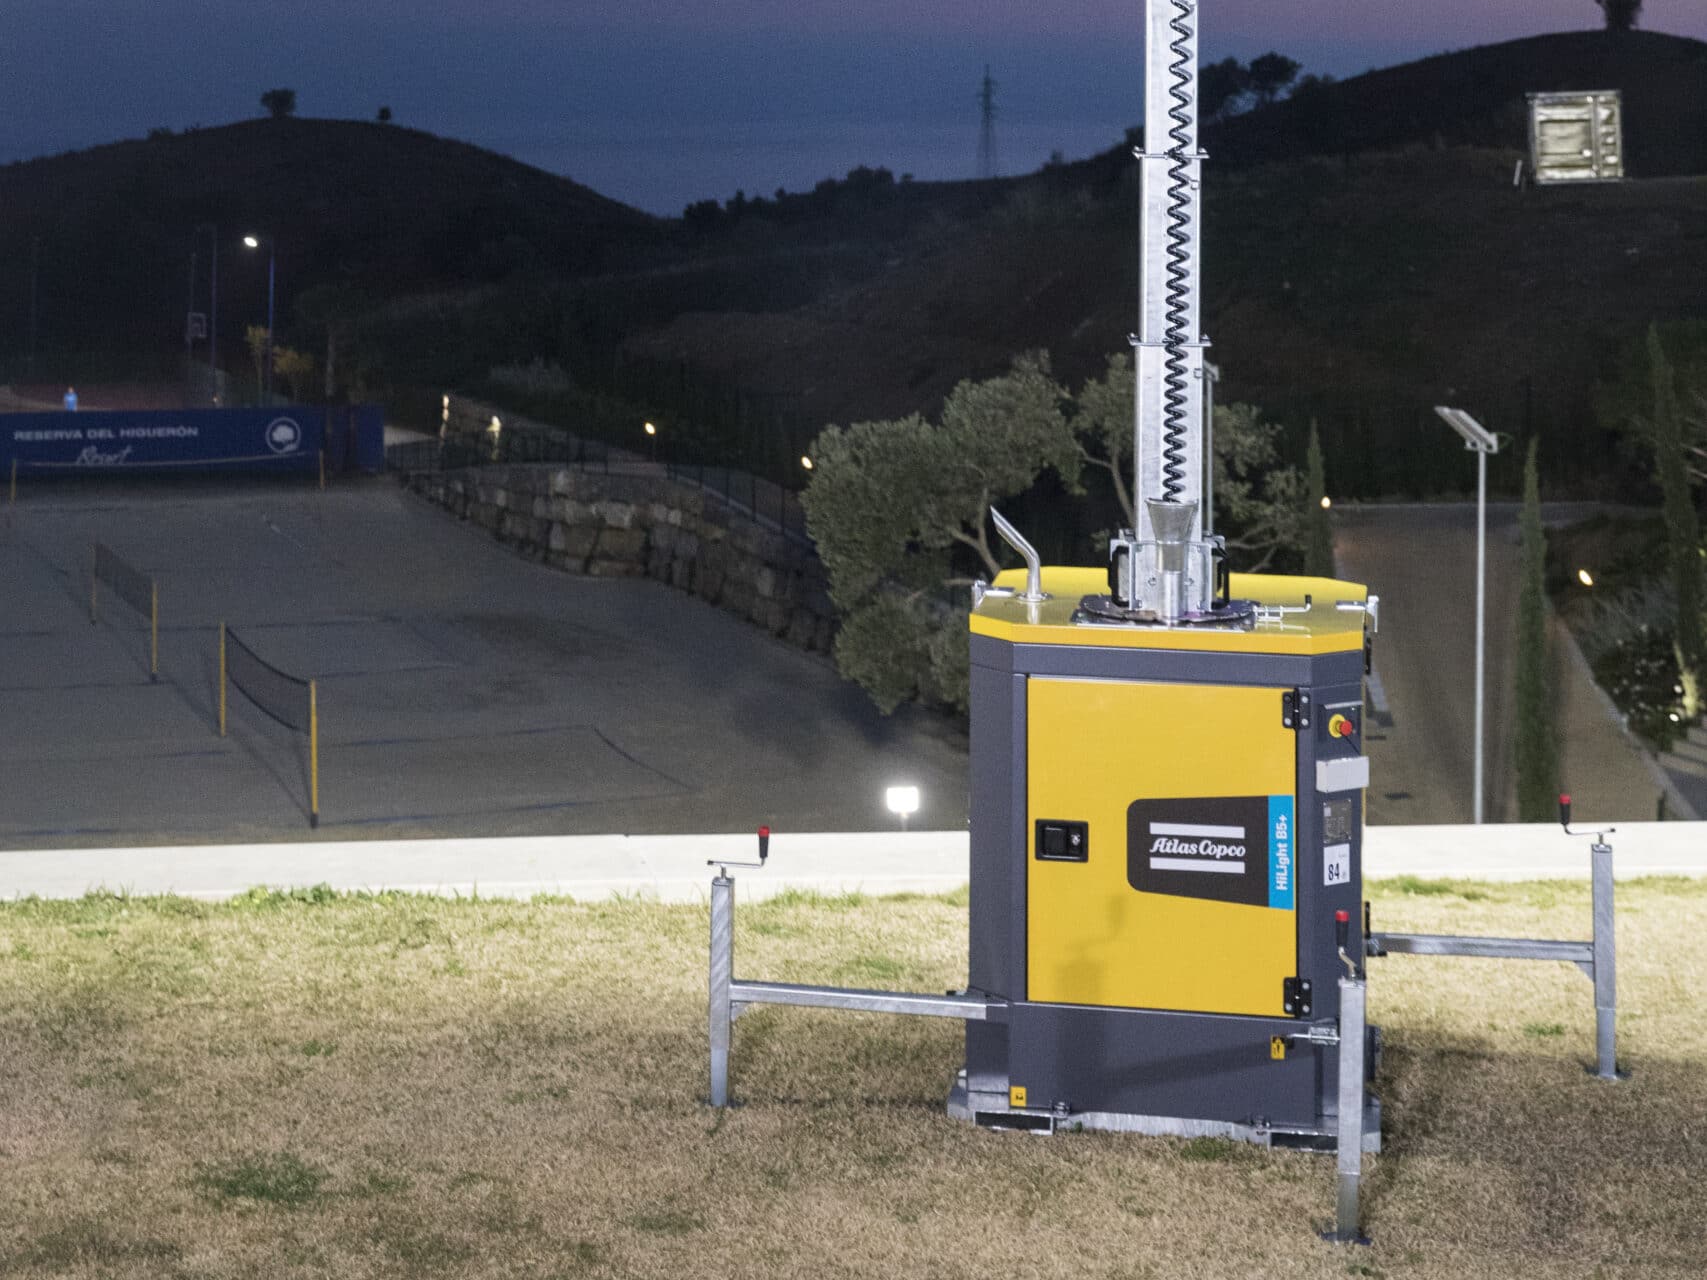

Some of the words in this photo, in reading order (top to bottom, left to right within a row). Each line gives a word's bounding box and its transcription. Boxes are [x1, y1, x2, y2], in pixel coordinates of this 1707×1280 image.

[14, 429, 82, 440] RESERVA
[87, 428, 115, 439] DEL
[120, 426, 198, 437] HIGUERÓN
[1275, 814, 1288, 839] B5+
[1149, 837, 1198, 855] Atlas
[1198, 839, 1246, 859] Copco
[1275, 843, 1290, 890] HiLight
[1328, 862, 1339, 881] 84
